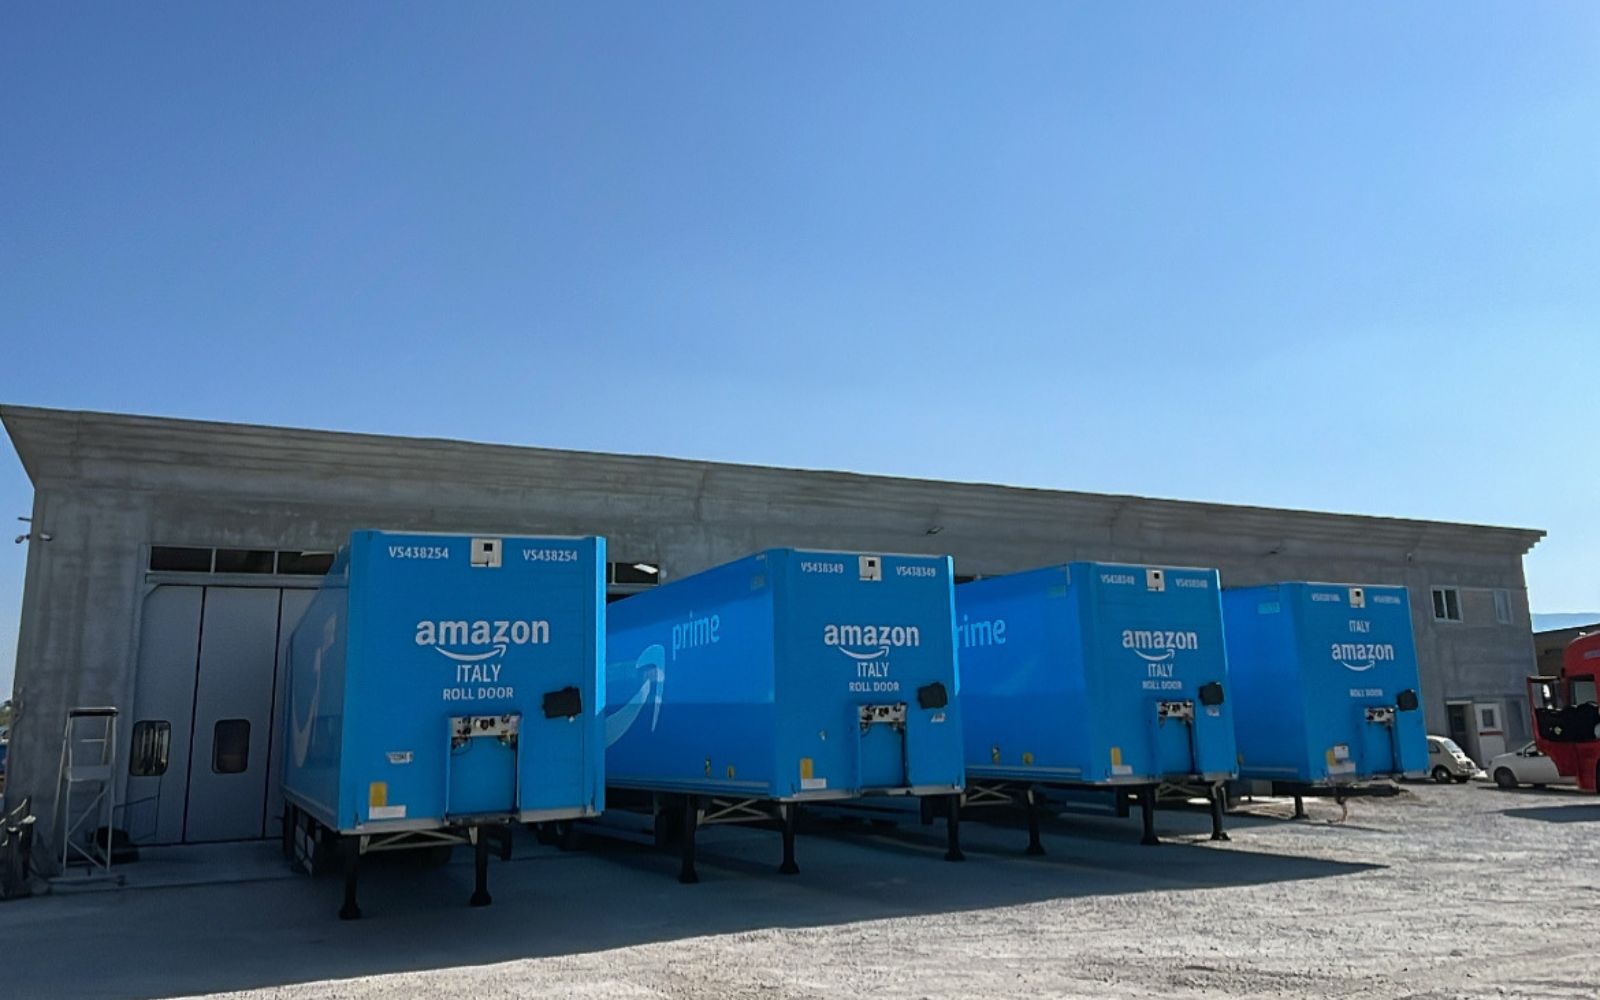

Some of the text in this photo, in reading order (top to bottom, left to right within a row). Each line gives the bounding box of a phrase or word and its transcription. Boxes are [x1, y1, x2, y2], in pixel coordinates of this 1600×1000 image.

[388, 546, 449, 560] VS438254
[523, 549, 578, 562] VS438254
[415, 620, 549, 645] amazon
[957, 614, 1006, 648] rime
[1349, 620, 1370, 633] ITALY
[672, 610, 720, 661] prime
[824, 624, 919, 647] amazon
[1122, 630, 1198, 650] amazon
[1331, 643, 1394, 660] amazon
[456, 664, 501, 682] ITALY
[857, 662, 889, 677] ITALY
[1148, 664, 1173, 677] ITALY
[443, 687, 514, 701] ROLL DOOR
[849, 681, 900, 692] ROLL DOOR
